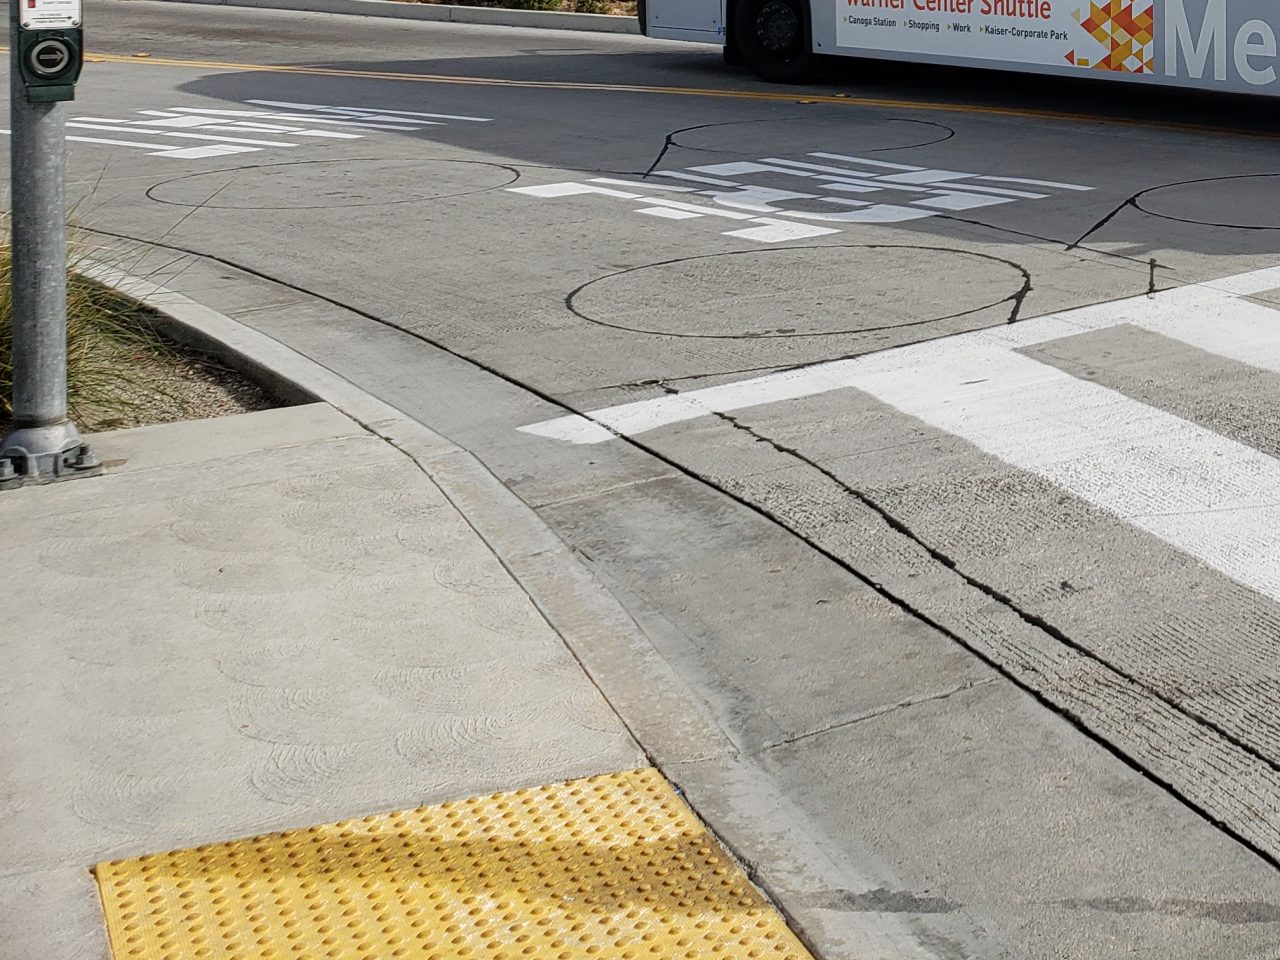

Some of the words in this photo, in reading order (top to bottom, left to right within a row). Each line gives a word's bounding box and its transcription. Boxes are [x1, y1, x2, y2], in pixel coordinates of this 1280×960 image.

[848, 15, 872, 27] Canoga
[873, 17, 897, 27] Station
[908, 19, 940, 32] Shopping
[952, 22, 972, 33] Work
[984, 25, 1049, 41] Kaiser-Corporate
[1050, 29, 1068, 41] Park
[504, 152, 1097, 243] HERE
